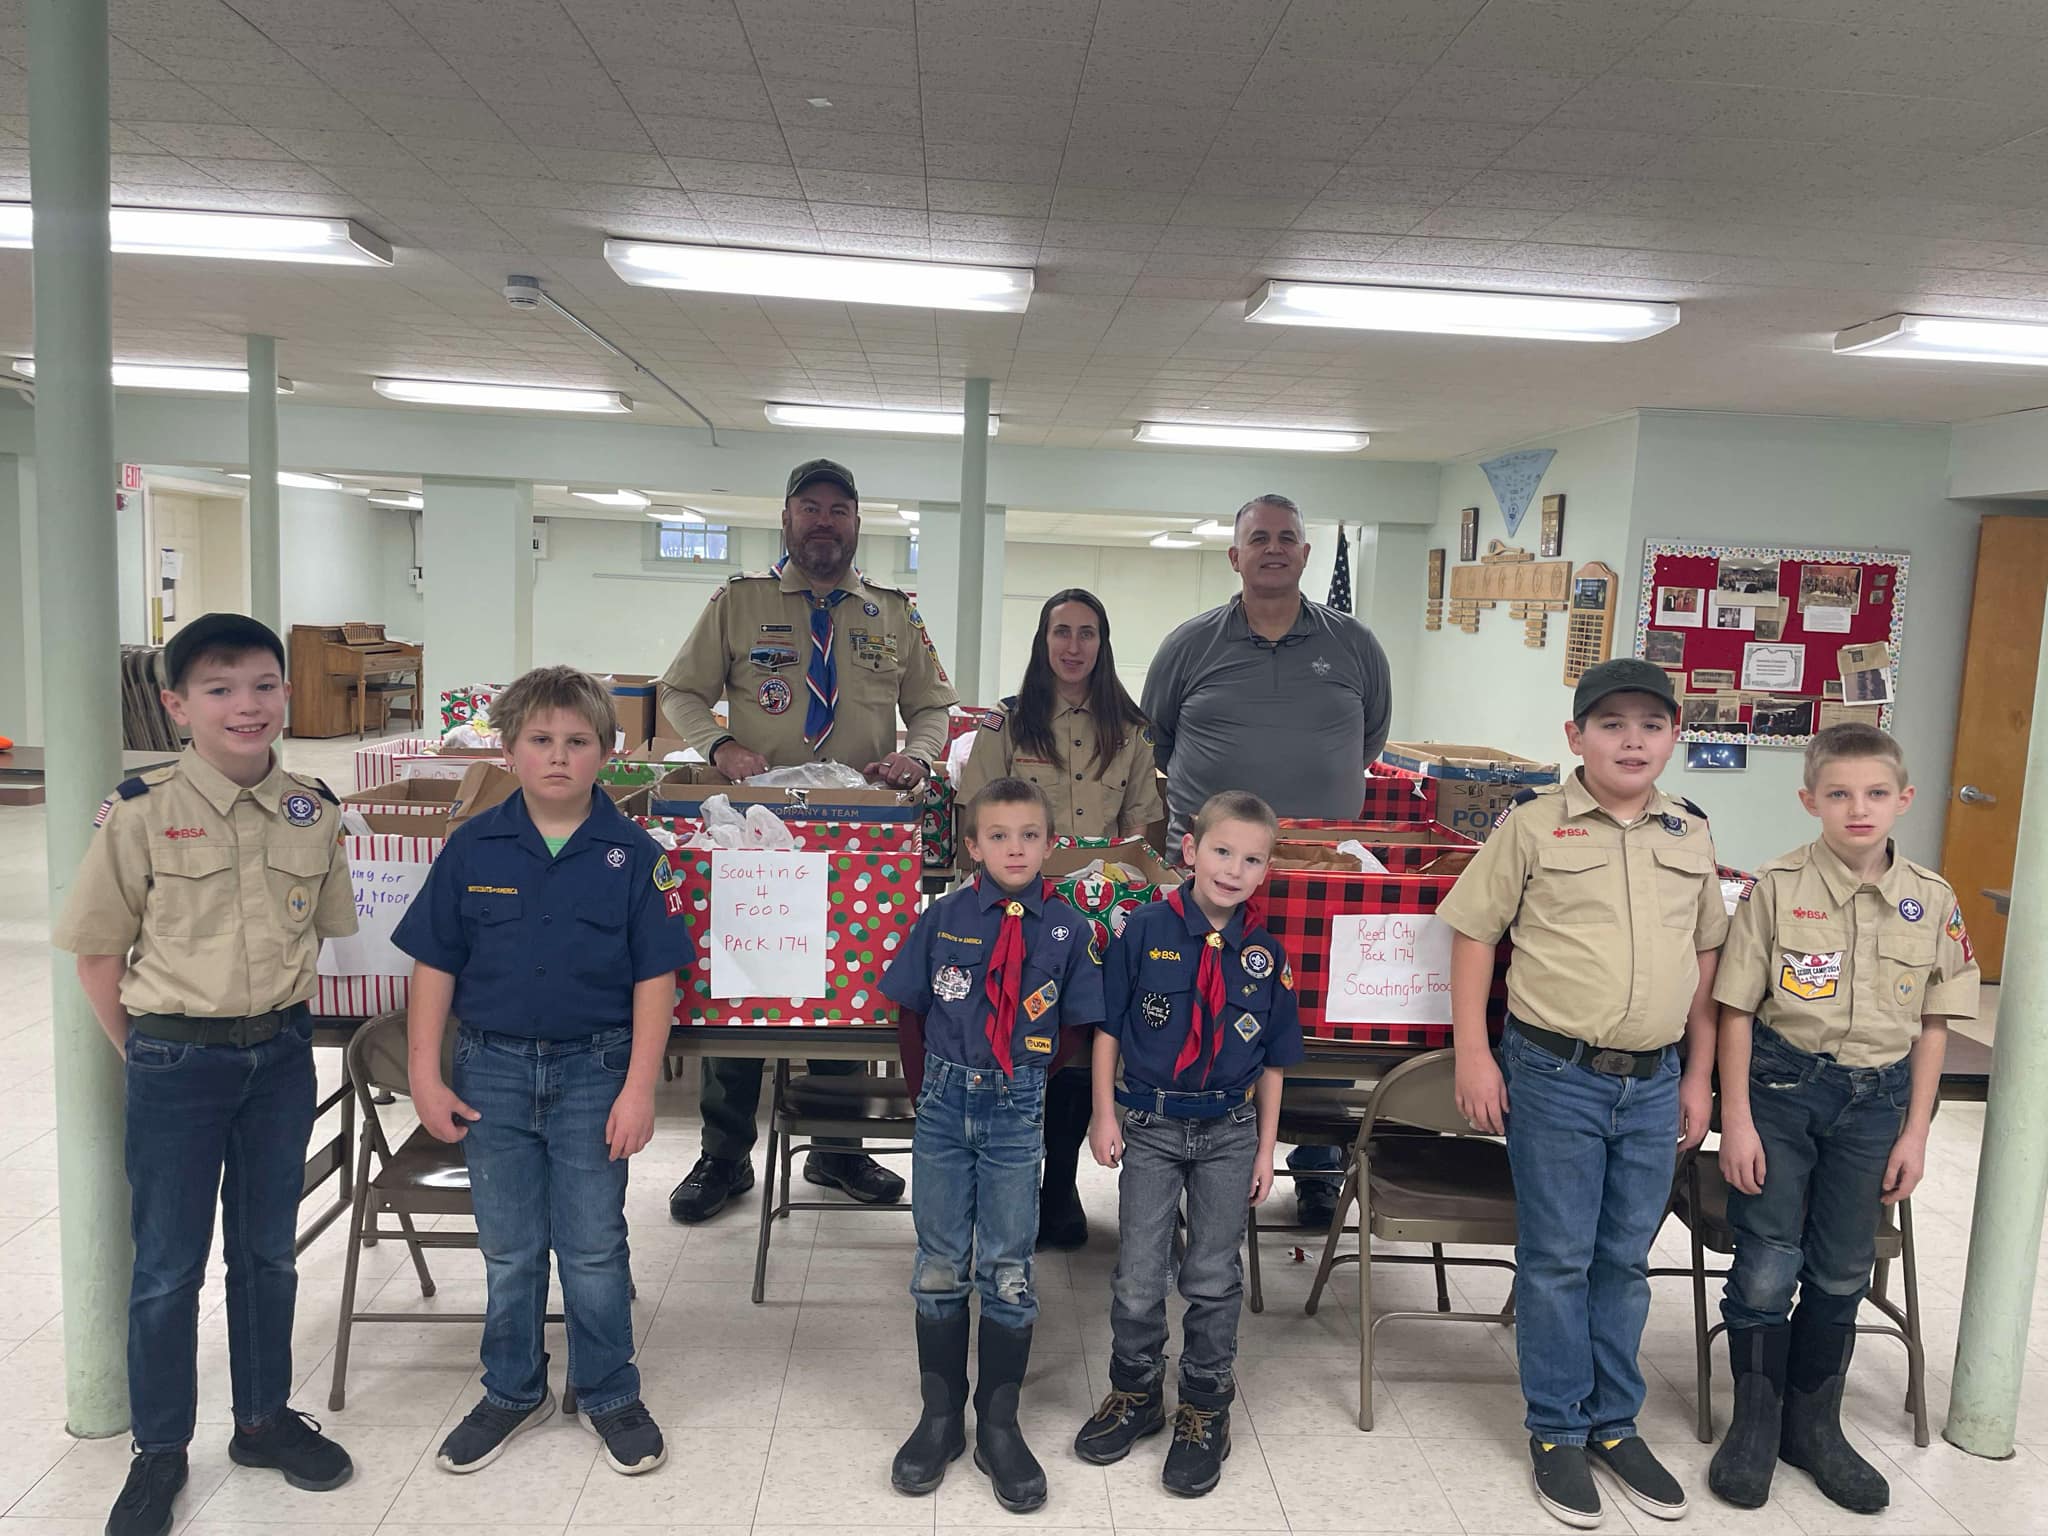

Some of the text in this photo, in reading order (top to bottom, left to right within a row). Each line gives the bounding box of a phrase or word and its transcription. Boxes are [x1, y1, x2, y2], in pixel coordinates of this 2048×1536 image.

[125, 465, 141, 489] EXIT
[831, 809, 859, 817] TEAM
[181, 828, 207, 839] BSA
[1567, 828, 1589, 838] BSA
[352, 869, 407, 883] ting for
[757, 884, 769, 900] 4
[356, 904, 374, 918] 74
[735, 903, 790, 917] FOOD
[1807, 911, 1828, 921] BSA
[1358, 919, 1416, 945] Reed City
[725, 934, 808, 953] PACK 174
[1161, 951, 1181, 962] BSA
[1360, 943, 1414, 965] Pack 174
[1344, 973, 1409, 1007] Scouting
[1409, 973, 1424, 997] for
